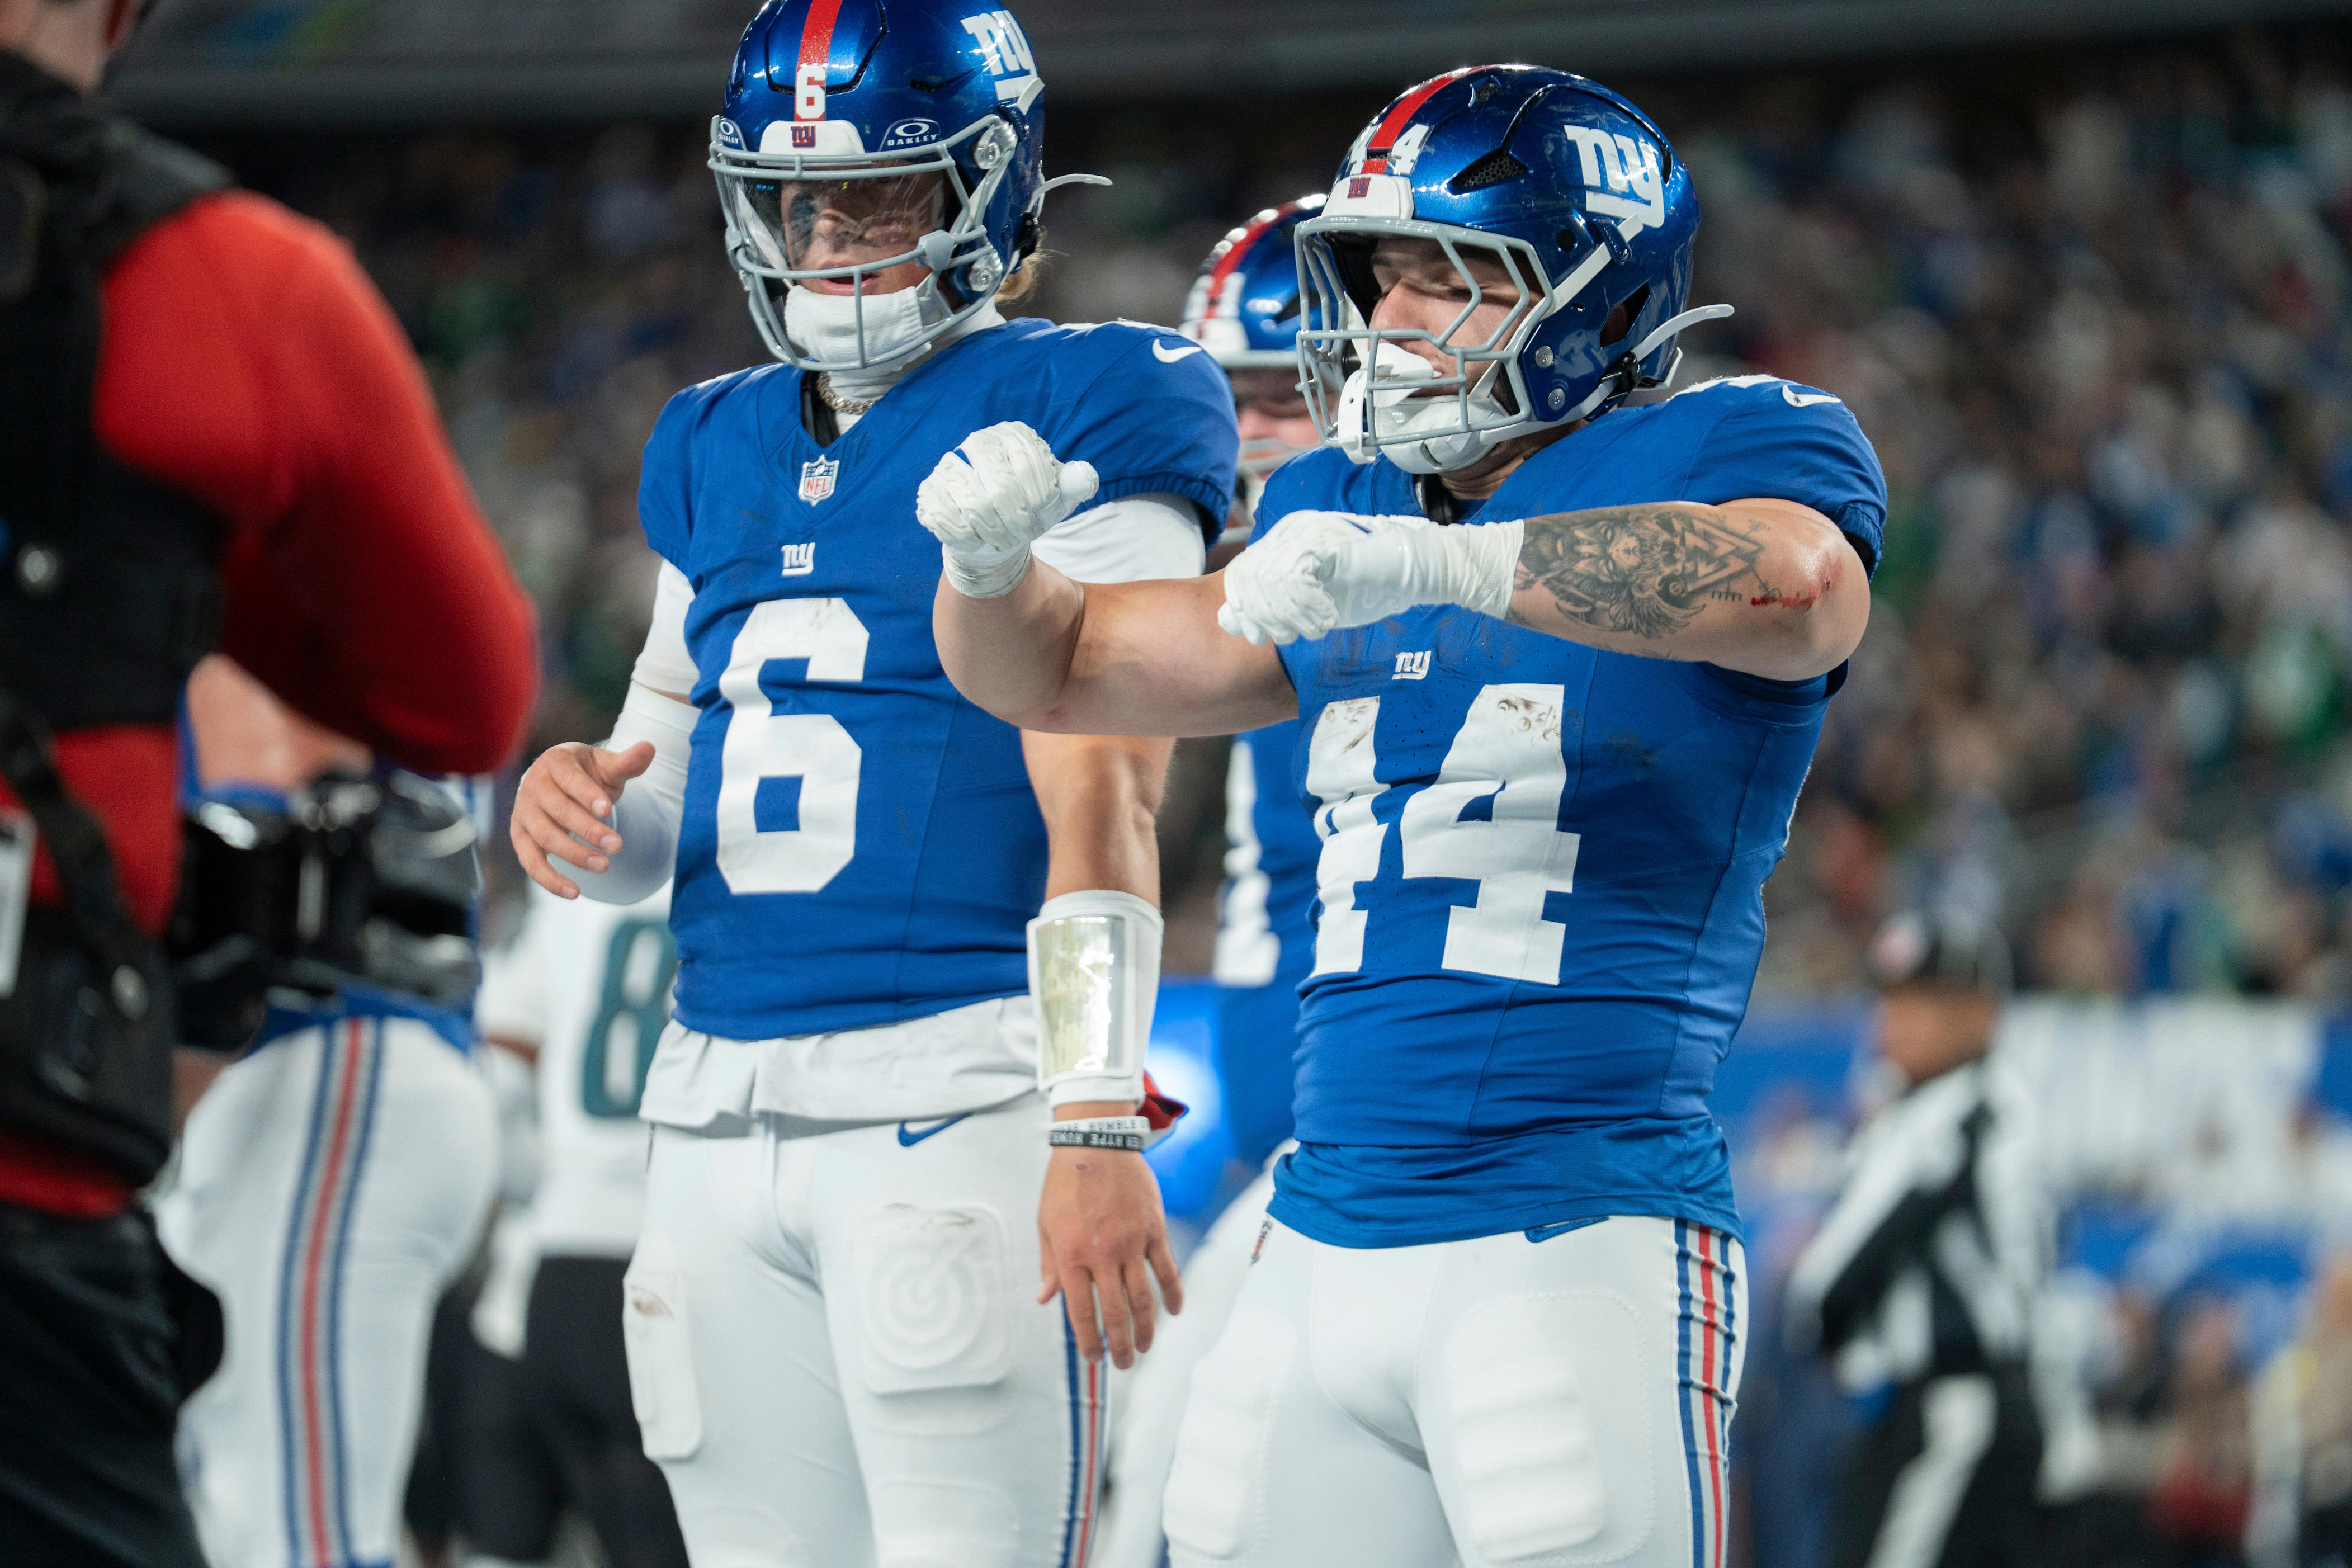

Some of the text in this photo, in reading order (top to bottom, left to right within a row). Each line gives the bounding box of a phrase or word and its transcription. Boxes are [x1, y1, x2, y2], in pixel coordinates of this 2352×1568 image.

[796, 65, 826, 119] 6
[791, 126, 816, 148] ny
[887, 134, 937, 146] OAKLEY
[1349, 123, 1430, 176] 44
[1348, 176, 1371, 199] ny
[805, 478, 829, 495] NFL
[781, 542, 816, 577] ny
[1391, 650, 1432, 680] ny
[716, 597, 870, 895] 6
[1305, 683, 1581, 986] 44
